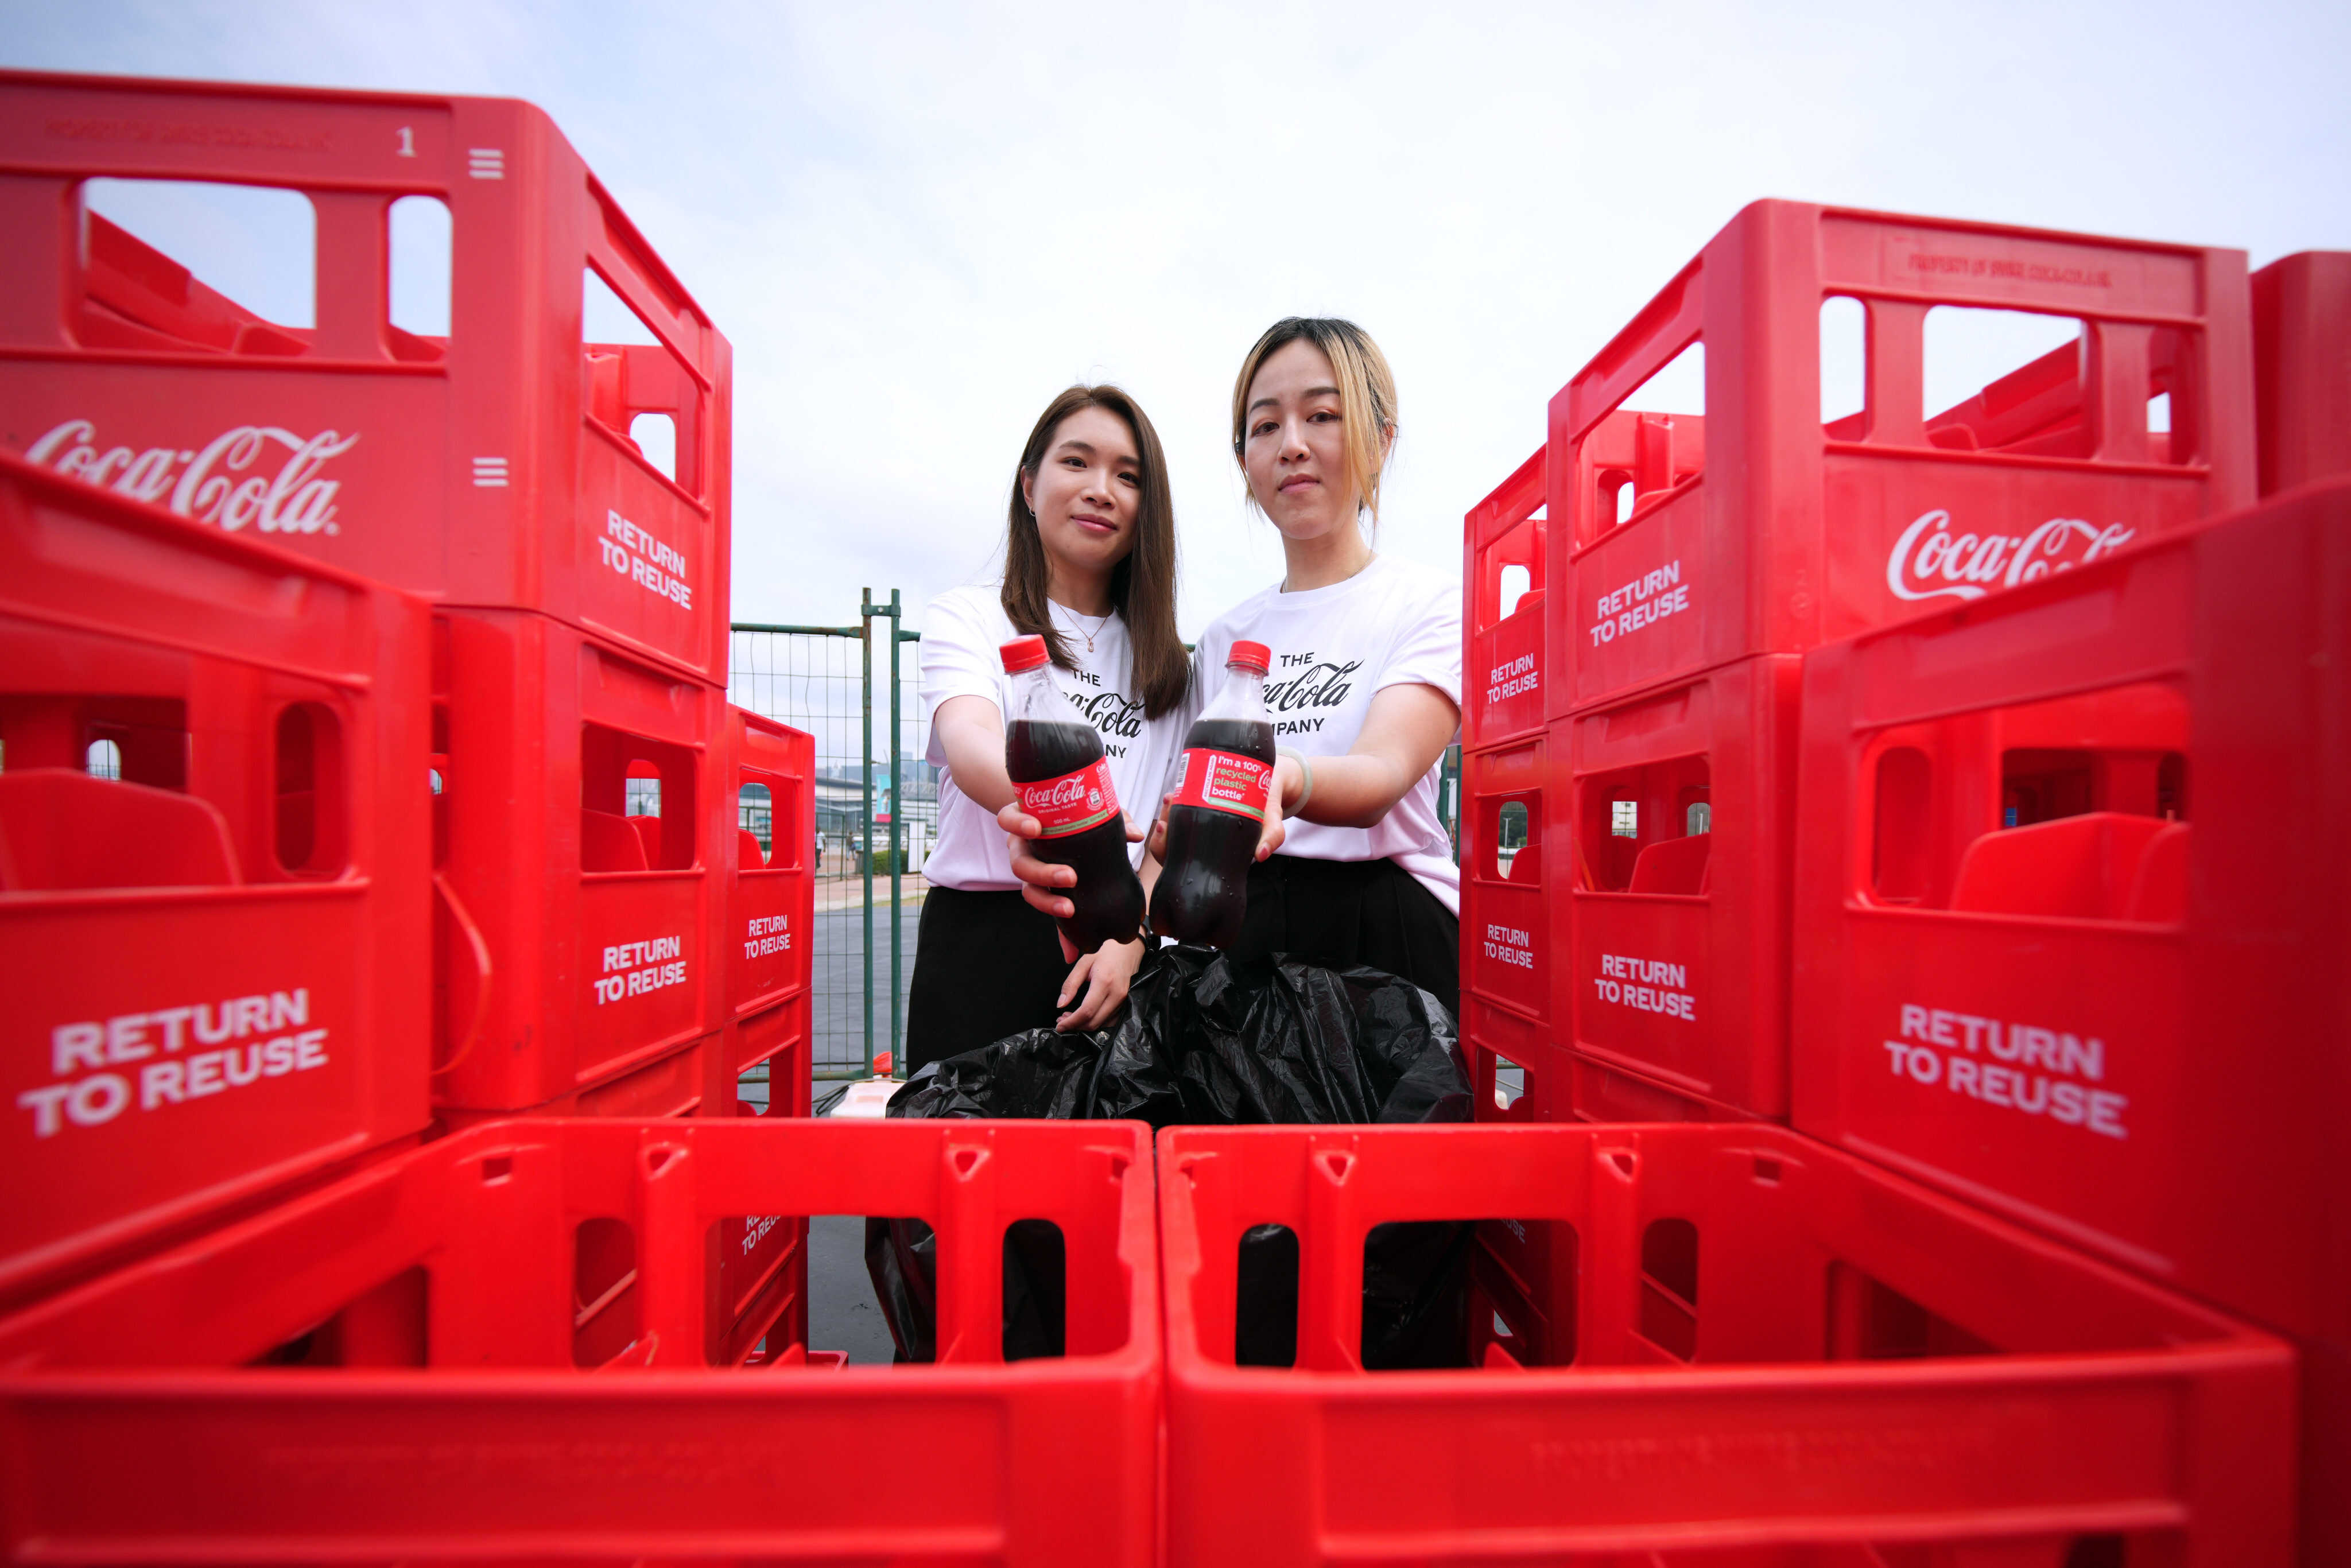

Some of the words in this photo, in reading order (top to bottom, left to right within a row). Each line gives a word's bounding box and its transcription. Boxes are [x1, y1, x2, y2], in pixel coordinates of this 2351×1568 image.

[397, 126, 417, 158] 1
[608, 509, 685, 579] RETURN
[598, 536, 630, 575] TO
[632, 556, 692, 610] REUSE
[1597, 560, 1679, 620] RETURN
[1590, 619, 1615, 647] TO
[1619, 584, 1689, 636] REUSE
[1280, 652, 1314, 667] THE
[1491, 653, 1534, 685] RETURN
[1071, 668, 1101, 687] THE
[1487, 684, 1500, 704] TO
[1502, 672, 1538, 698] REUSE
[1271, 718, 1325, 736] PANY
[1216, 767, 1256, 783] recycled
[1218, 755, 1233, 766] I'm
[1243, 760, 1262, 773] 100%
[1025, 773, 1085, 808] Coca-Cola
[1213, 777, 1247, 791] plastic
[1061, 802, 1077, 810] TASTE
[748, 915, 787, 937] RETURN
[1488, 924, 1528, 948] RETURN
[603, 936, 680, 972] RETURN
[744, 940, 759, 959] TO
[760, 933, 790, 956] REUSE
[1484, 941, 1496, 958] TO
[1498, 945, 1533, 969] REUSE
[595, 975, 624, 1005] TO
[628, 961, 686, 996] REUSE
[1602, 954, 1685, 988] RETURN
[1595, 979, 1620, 1003] TO
[1624, 984, 1696, 1021] REUSE
[52, 987, 309, 1076] RETURN
[1900, 1003, 2104, 1081] RETURN
[16, 1073, 130, 1138] TO
[139, 1028, 328, 1112] REUSE
[1883, 1039, 1942, 1085] TO
[1948, 1055, 2128, 1140] REUSE
[742, 1230, 757, 1256] TO
[758, 1215, 781, 1241] REU
